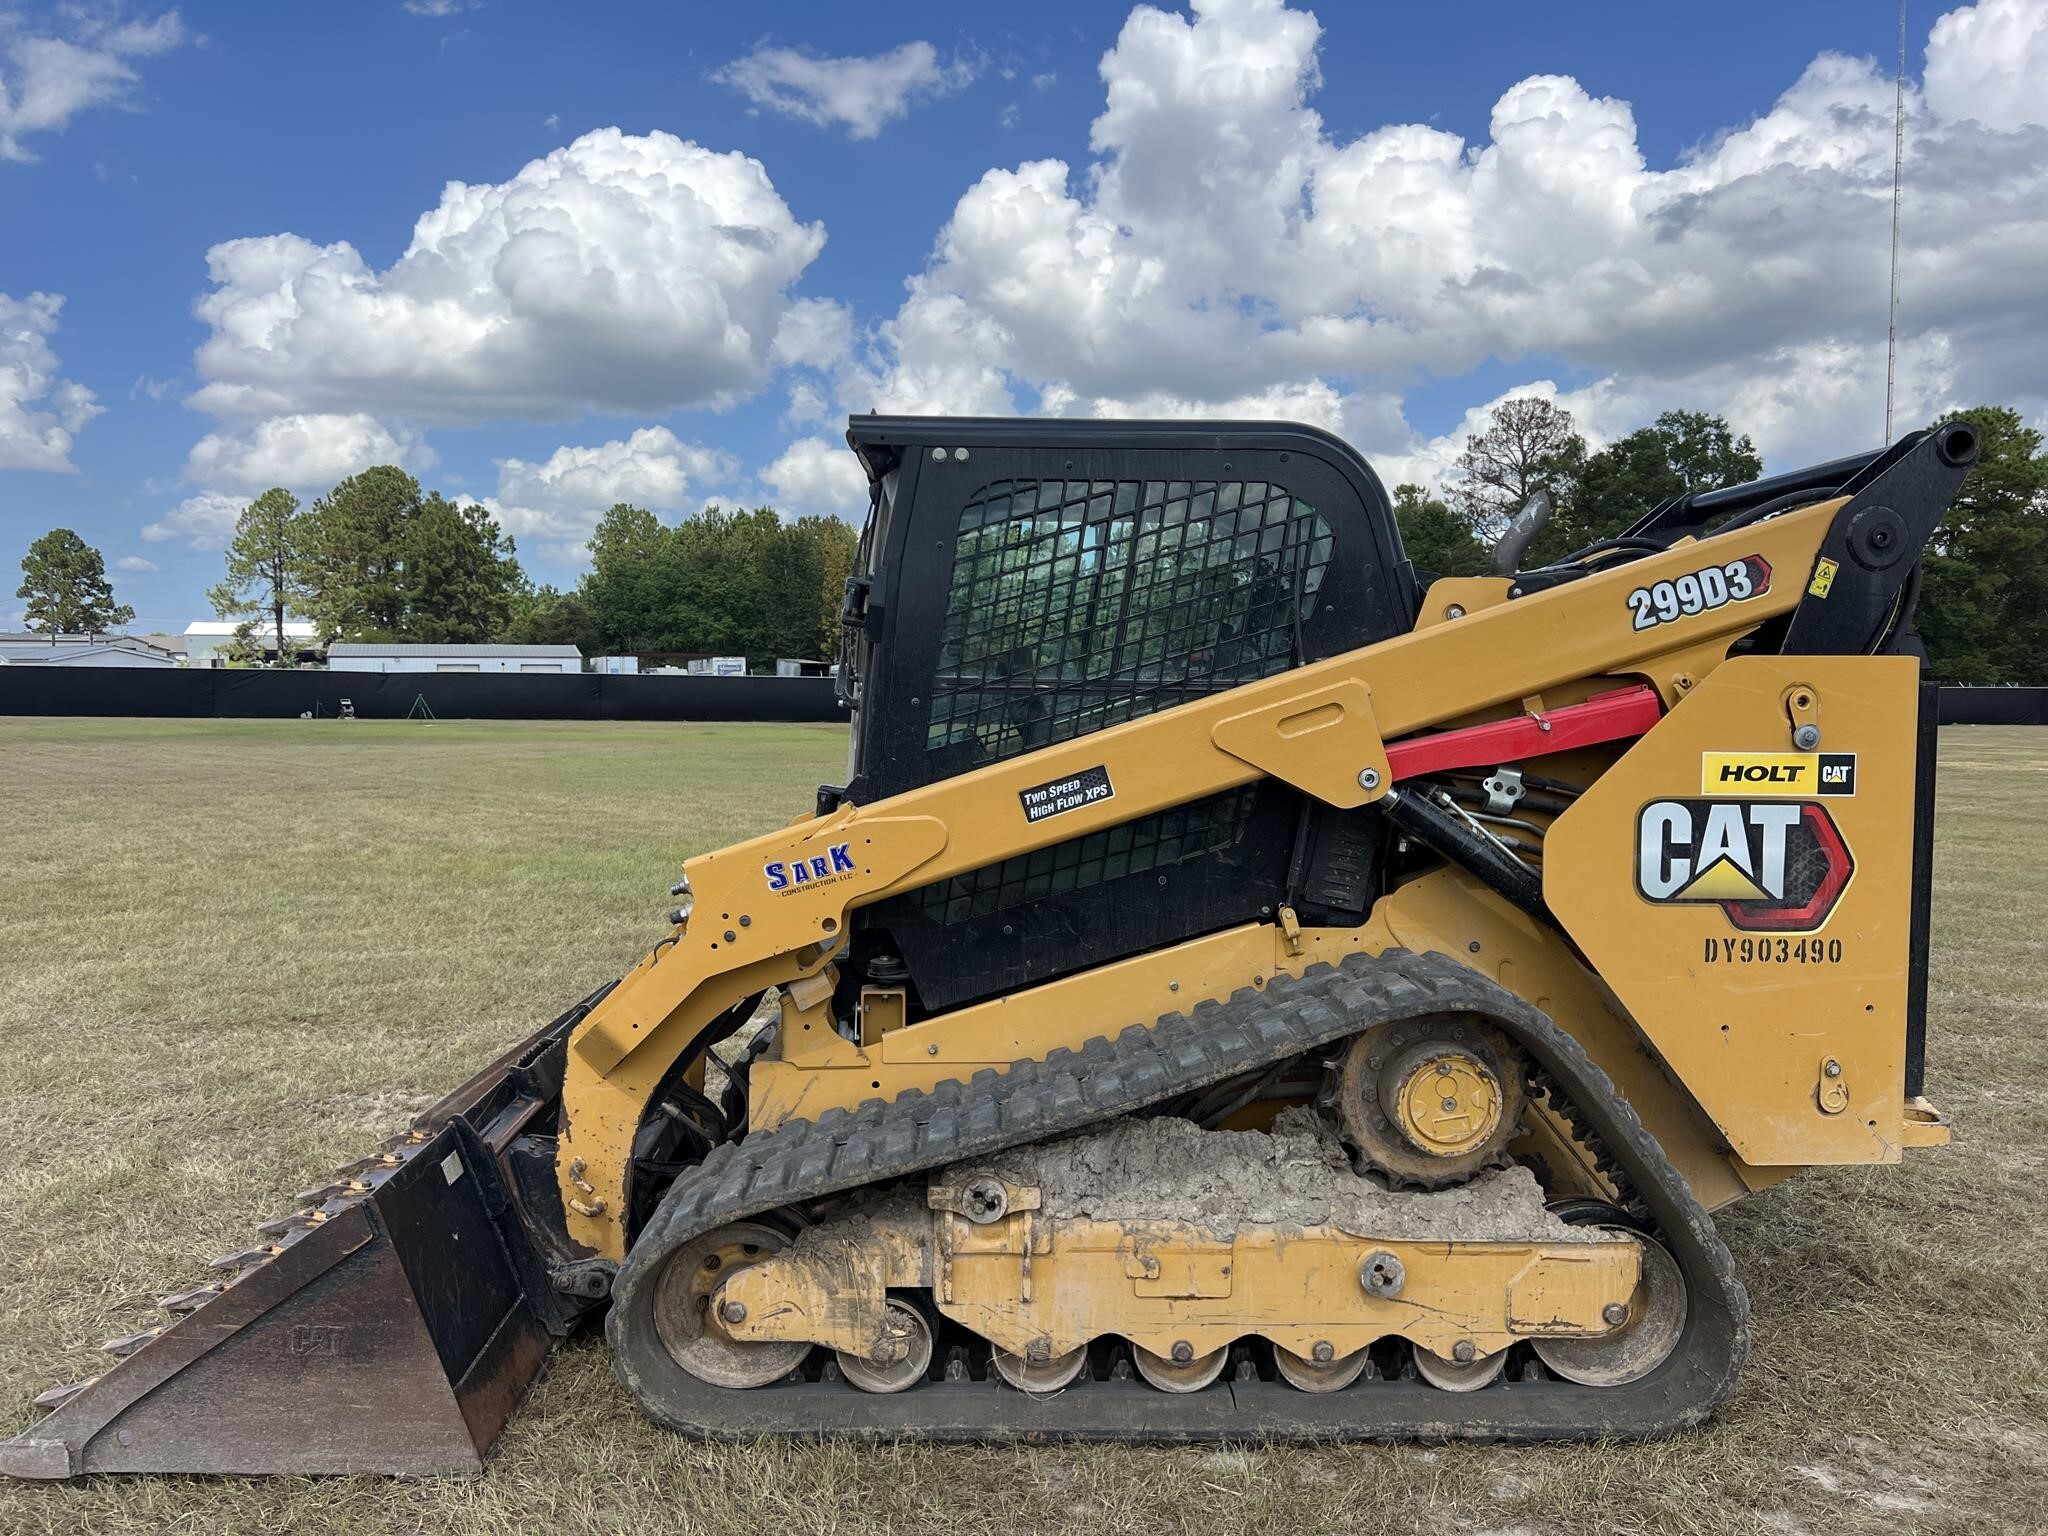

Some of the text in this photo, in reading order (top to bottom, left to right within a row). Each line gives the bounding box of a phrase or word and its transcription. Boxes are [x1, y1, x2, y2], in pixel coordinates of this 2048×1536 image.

[1628, 560, 1753, 630] 299D3
[1719, 765, 1806, 782] HOLT
[1822, 765, 1849, 783] CAT
[1085, 783, 1108, 801] XPS
[1640, 801, 1801, 900] CAT
[781, 872, 853, 898] CONSTRUCTION LLC
[1703, 938, 1843, 964] DY903490
